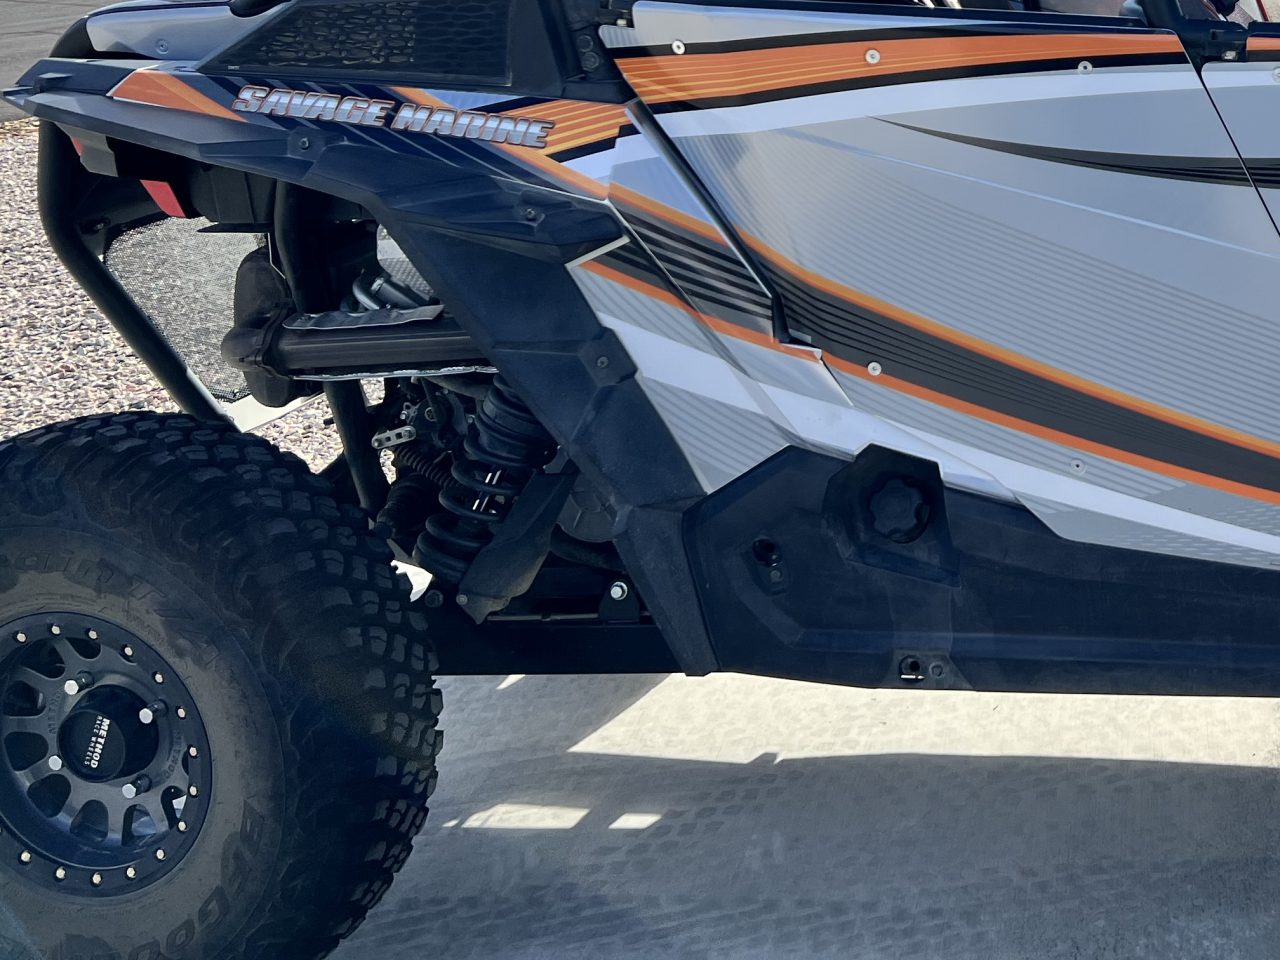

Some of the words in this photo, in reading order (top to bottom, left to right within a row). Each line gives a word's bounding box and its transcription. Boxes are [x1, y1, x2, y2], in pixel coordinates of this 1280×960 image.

[232, 84, 395, 128] SAVAGE
[391, 102, 555, 148] MARINE
[90, 718, 110, 768] METHOD
